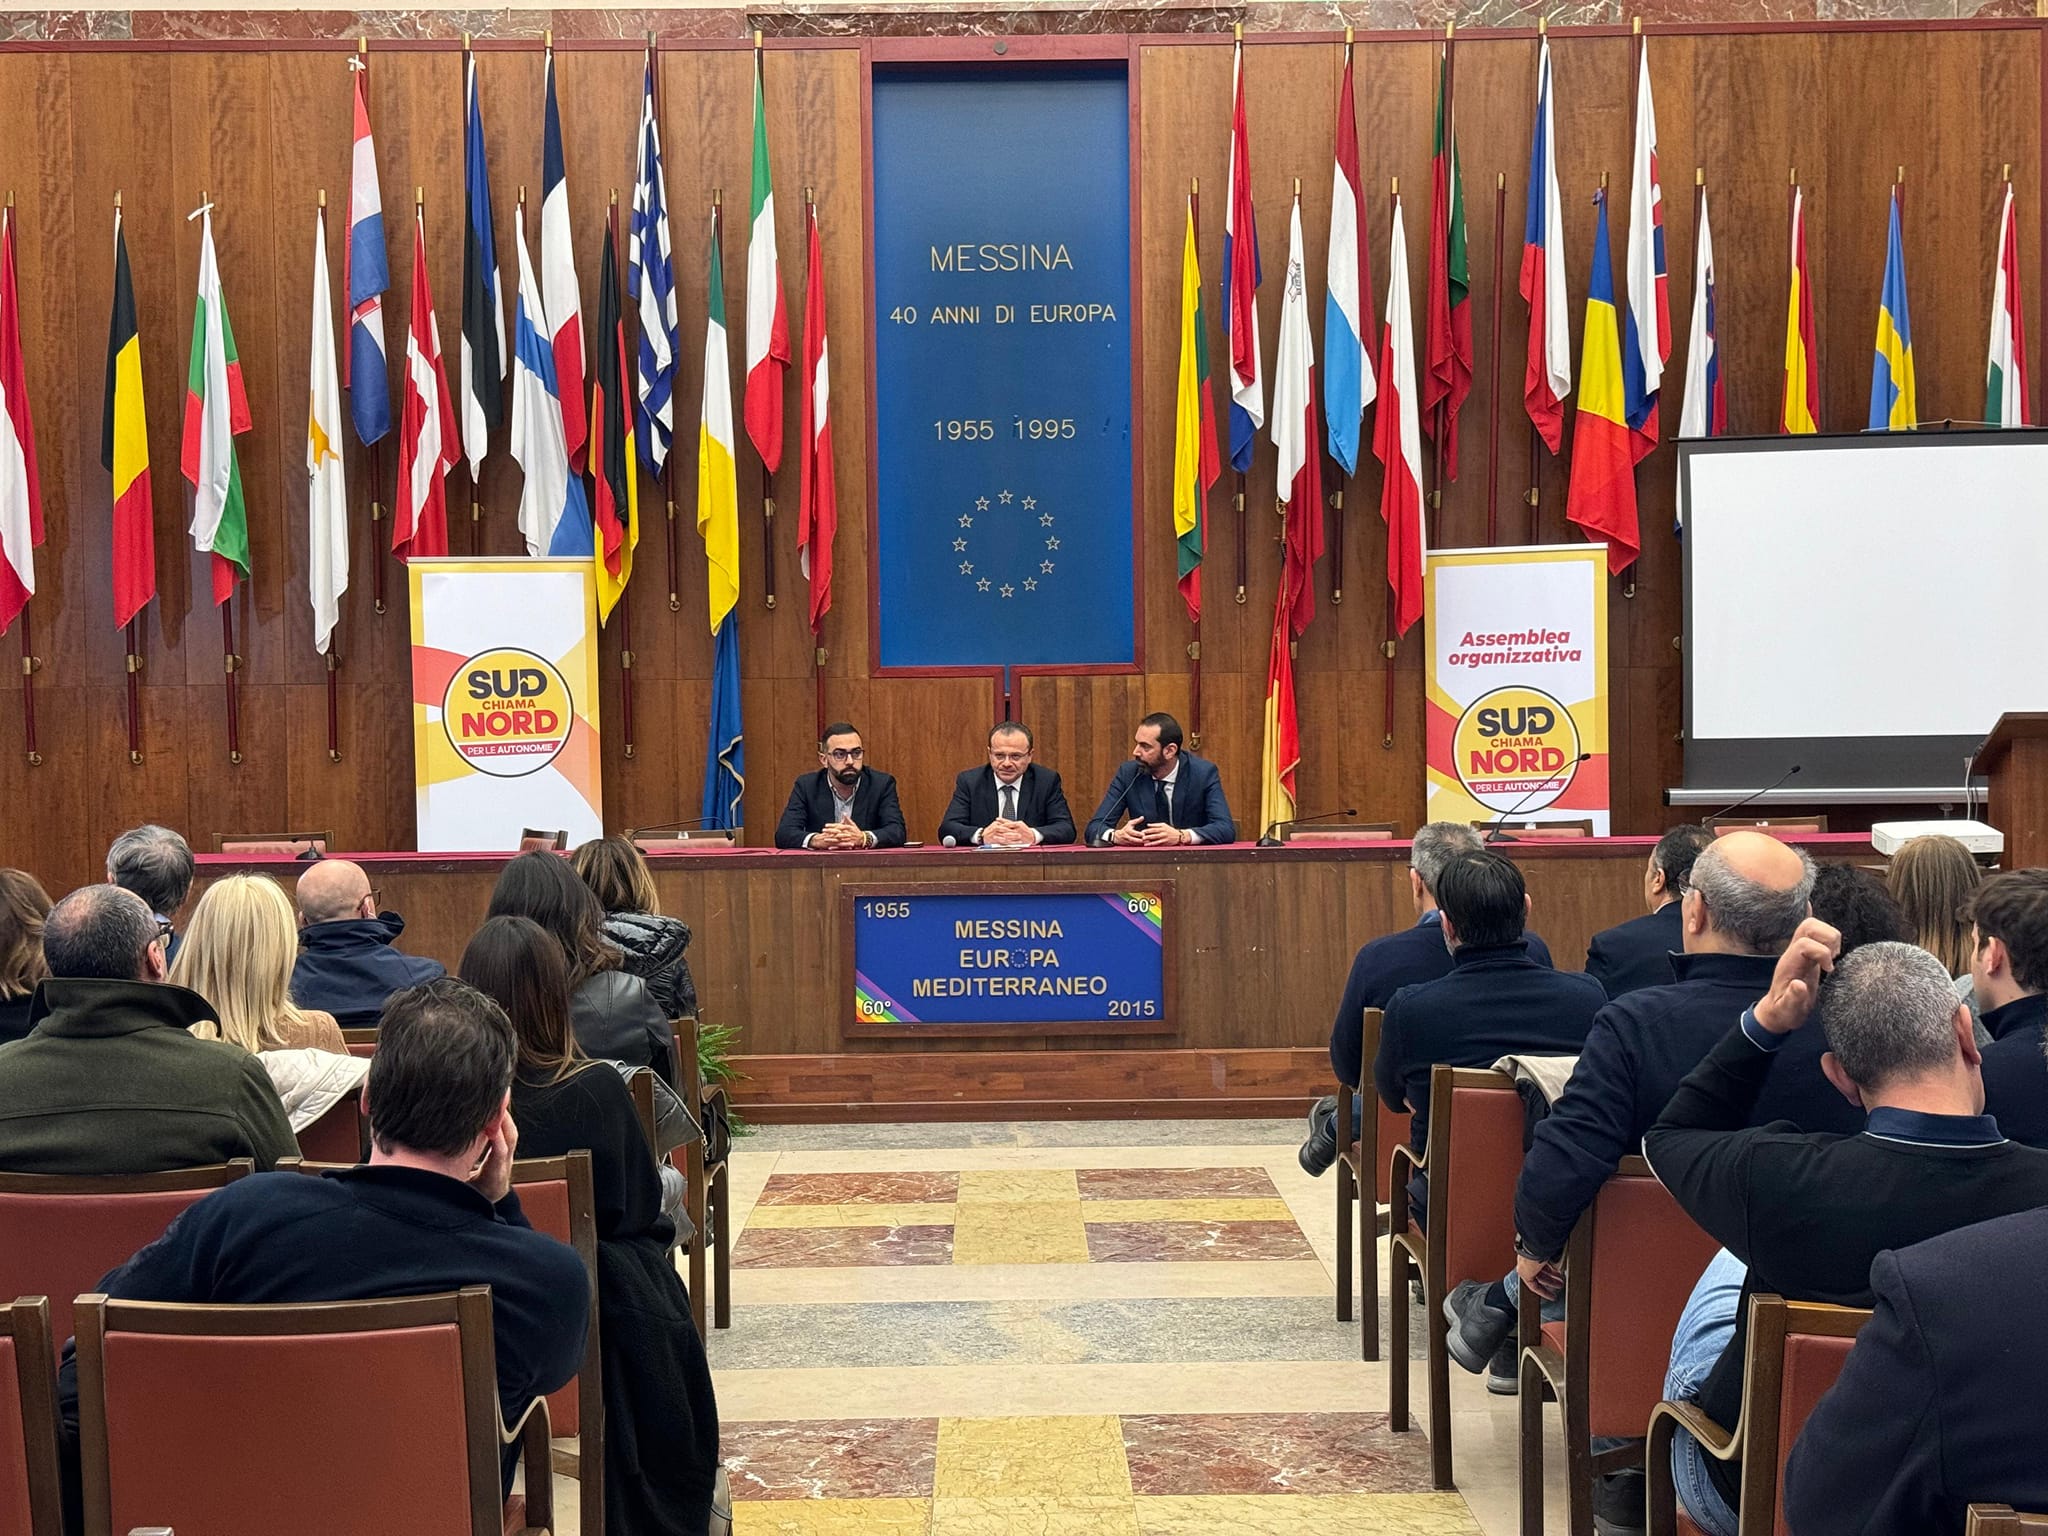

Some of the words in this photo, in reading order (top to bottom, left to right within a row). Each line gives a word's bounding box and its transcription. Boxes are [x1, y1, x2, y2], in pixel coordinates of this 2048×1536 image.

[931, 244, 1074, 272] MESSINA
[890, 306, 917, 325] 40
[930, 306, 980, 325] ANNI
[995, 305, 1015, 324] DI
[1030, 303, 1117, 323] EUROPA
[934, 420, 994, 441] 1955
[1014, 418, 1076, 440] 1995
[1459, 628, 1570, 647] Assemblea
[1448, 645, 1582, 669] organizzativa
[468, 668, 547, 700] SUD
[482, 699, 536, 710] CHIAMA
[461, 709, 558, 738] NORD
[1477, 706, 1555, 737] SUD
[467, 746, 484, 756] PER
[485, 745, 496, 755] LE
[497, 743, 553, 754] AUTONOMIE
[1490, 738, 1543, 748] CHIAMA
[1470, 747, 1565, 775] NORD
[1475, 784, 1492, 793] PER
[1493, 783, 1503, 792] LE
[863, 902, 910, 919] 1955
[1128, 898, 1156, 913] 60°
[955, 920, 1064, 939] MESSINA
[912, 976, 1108, 997] MEDITERRANEO
[862, 1000, 891, 1015] 60°
[1107, 1000, 1155, 1016] 2015
